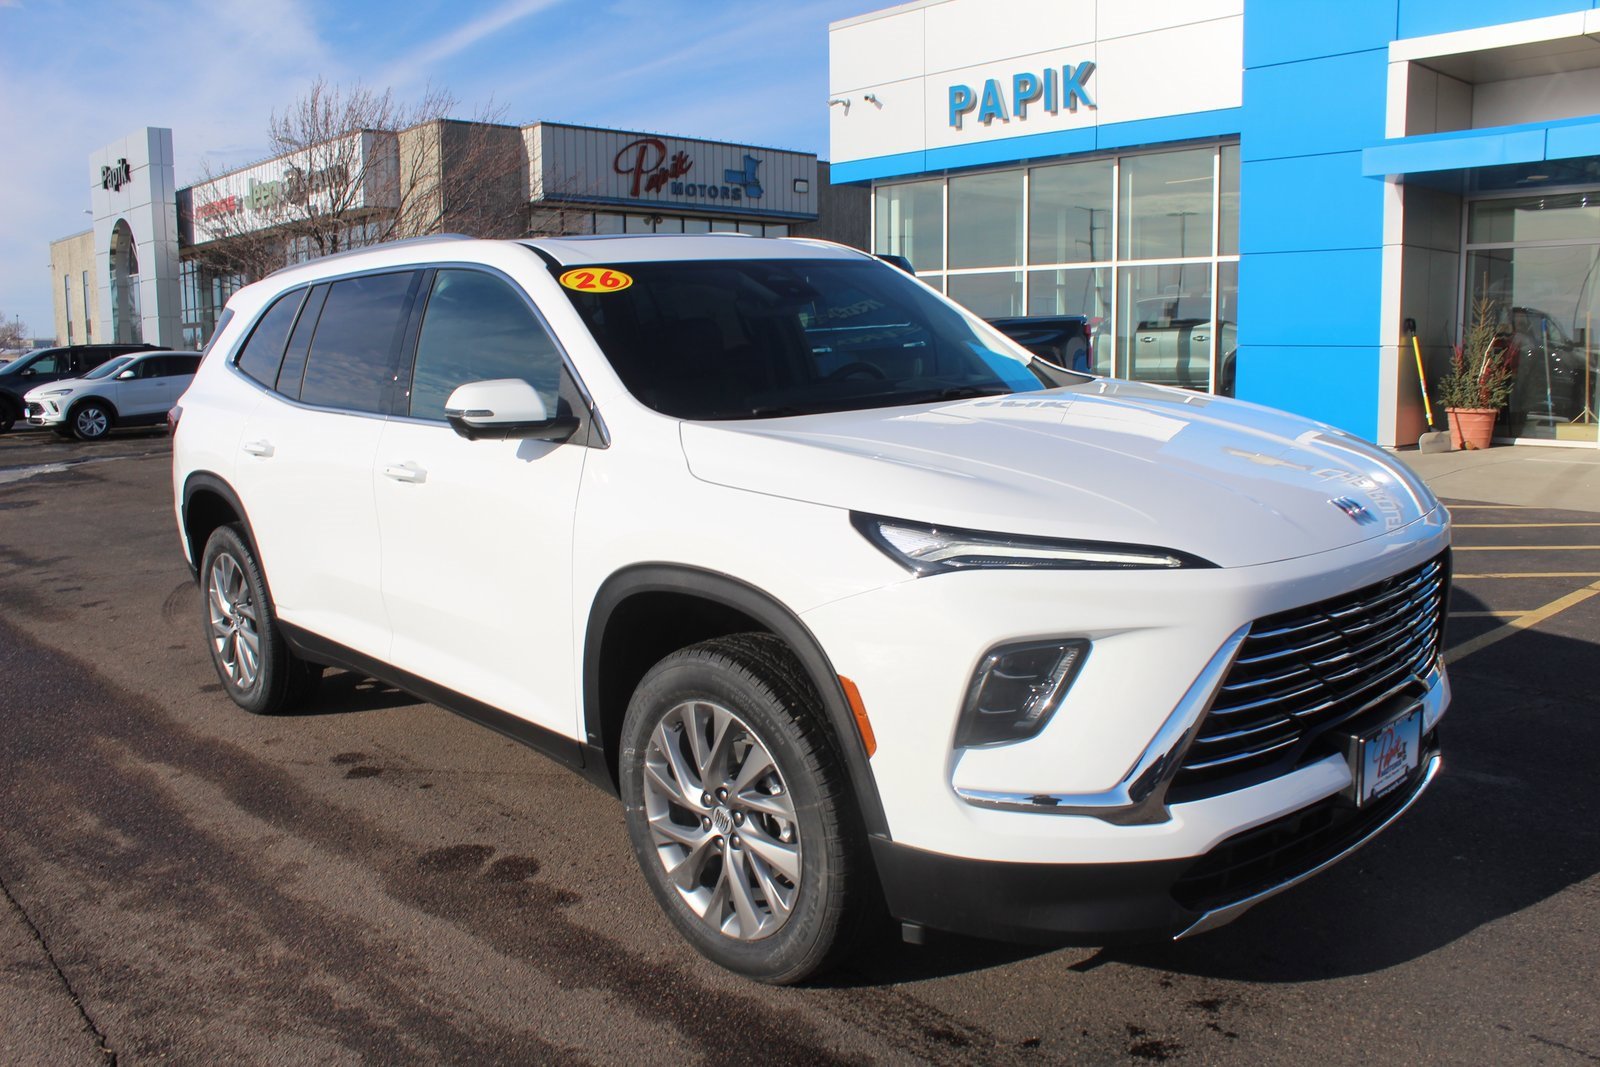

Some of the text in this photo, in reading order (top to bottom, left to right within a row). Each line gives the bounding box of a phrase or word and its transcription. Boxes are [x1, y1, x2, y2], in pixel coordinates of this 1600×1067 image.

[948, 61, 1097, 130] PAPIK
[101, 158, 131, 191] Papik
[671, 181, 742, 200] MOTORS
[575, 271, 620, 288] 26
